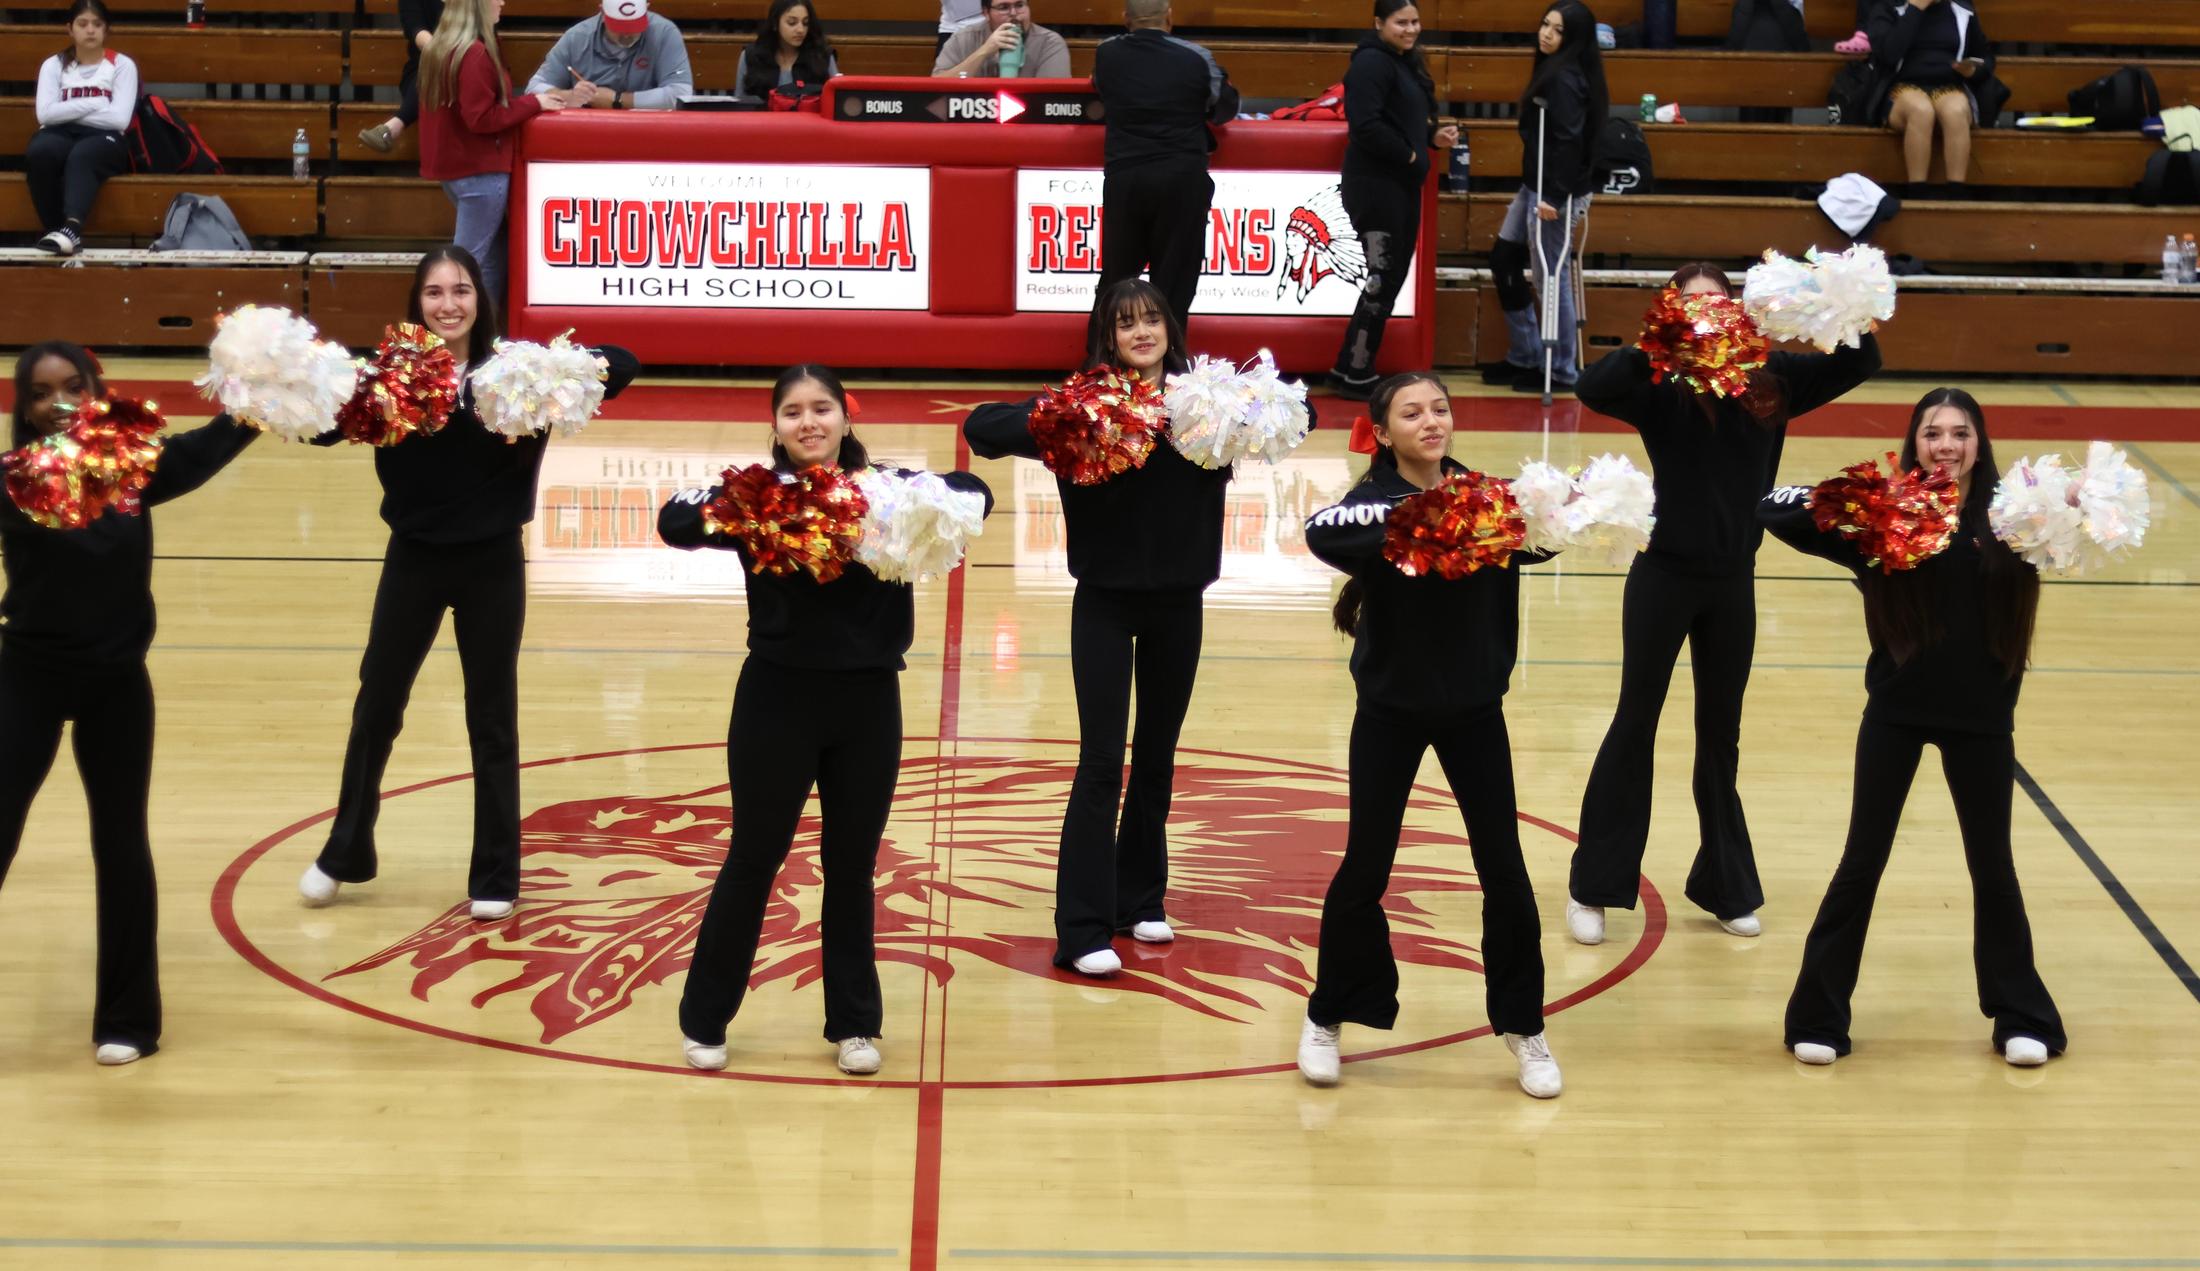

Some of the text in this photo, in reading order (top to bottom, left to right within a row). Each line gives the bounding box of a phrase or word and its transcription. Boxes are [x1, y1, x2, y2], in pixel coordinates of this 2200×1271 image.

[618, 2, 636, 17] C
[865, 100, 903, 114] BONUS
[949, 97, 998, 119] POSS
[1045, 103, 1082, 116] BONUS
[1602, 166, 1640, 194] P
[541, 196, 917, 271] CHOWCHILLA
[1028, 203, 1275, 276] RENS
[602, 276, 856, 299] HIGH SCHOOL
[1026, 283, 1089, 295] Redskin
[1231, 286, 1270, 298] Wide
